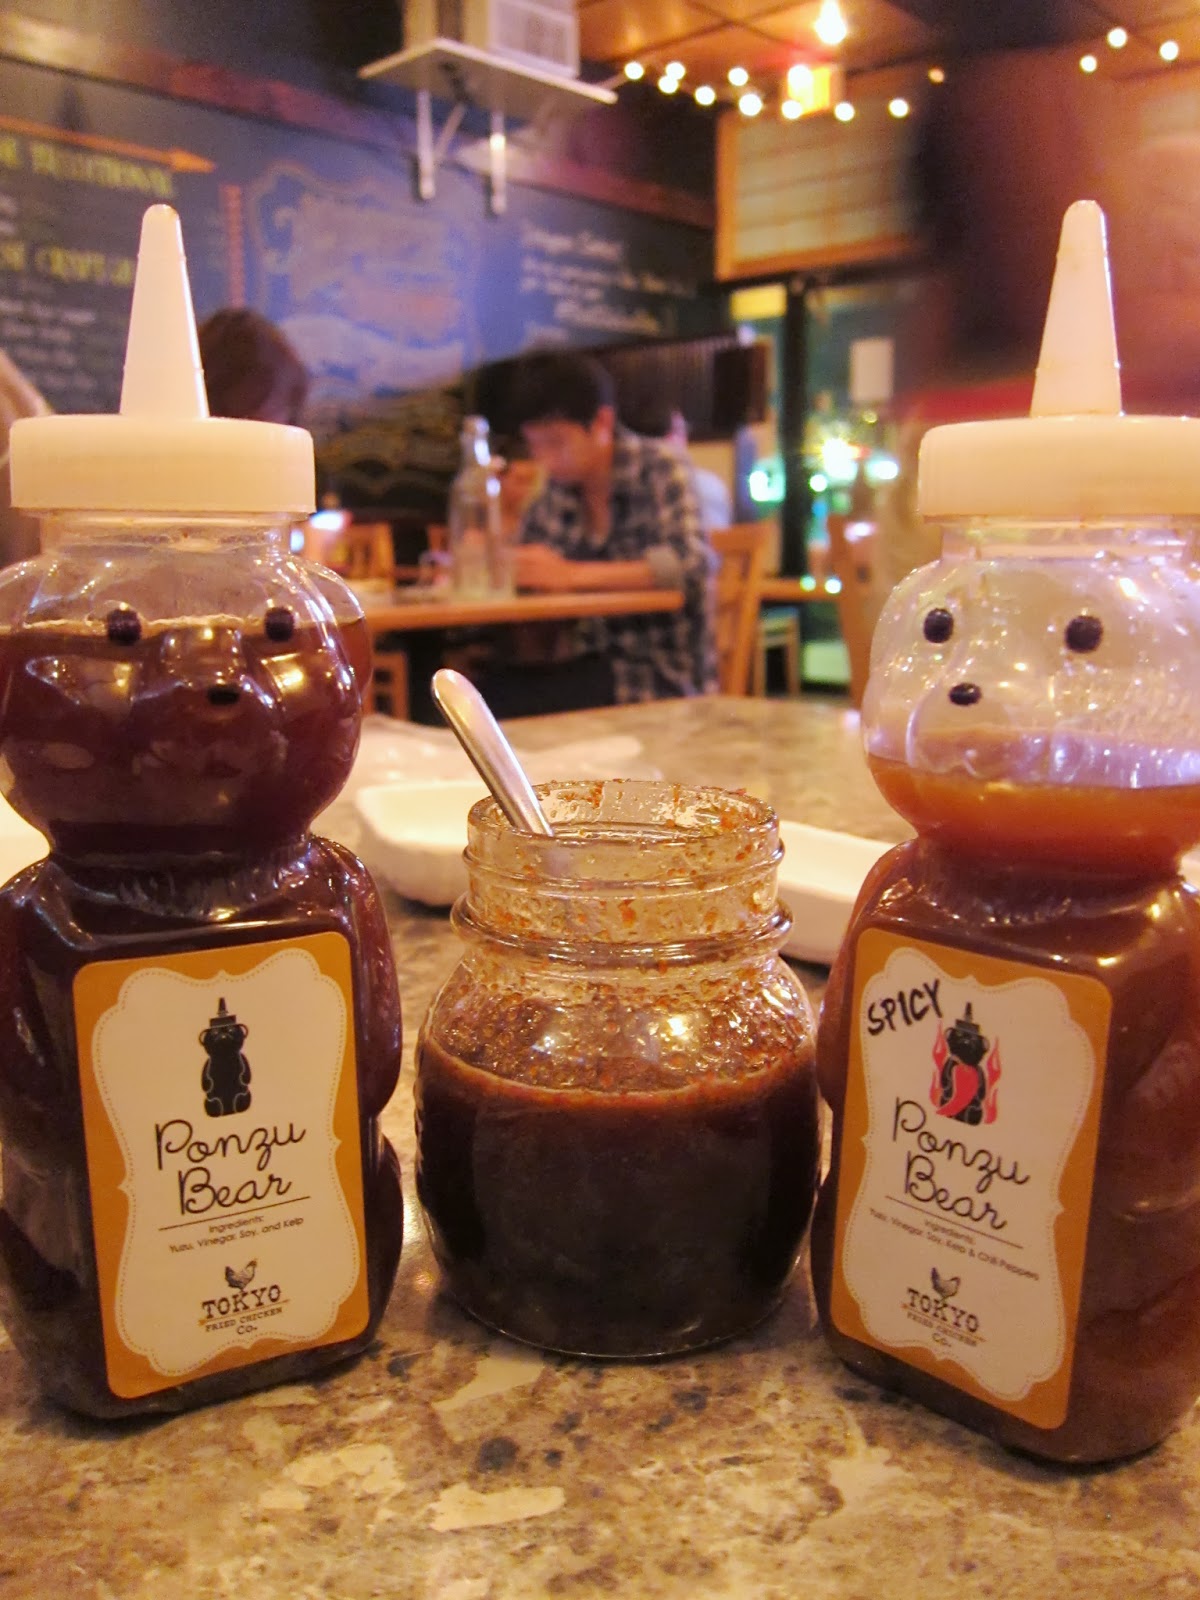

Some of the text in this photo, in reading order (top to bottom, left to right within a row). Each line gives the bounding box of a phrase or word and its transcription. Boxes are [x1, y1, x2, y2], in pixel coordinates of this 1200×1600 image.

[867, 979, 943, 1036] SPICY
[155, 1119, 306, 1171] Ponzu
[893, 1097, 1030, 1193] Ponzu
[178, 1166, 292, 1215] Bear
[904, 1151, 1007, 1230] Bear
[261, 1222, 281, 1233] and
[283, 1217, 304, 1228] Kelp
[201, 1284, 281, 1319] TOKYO
[205, 1306, 284, 1332] FRIED CHICKEN
[907, 1287, 979, 1333] TOKYO
